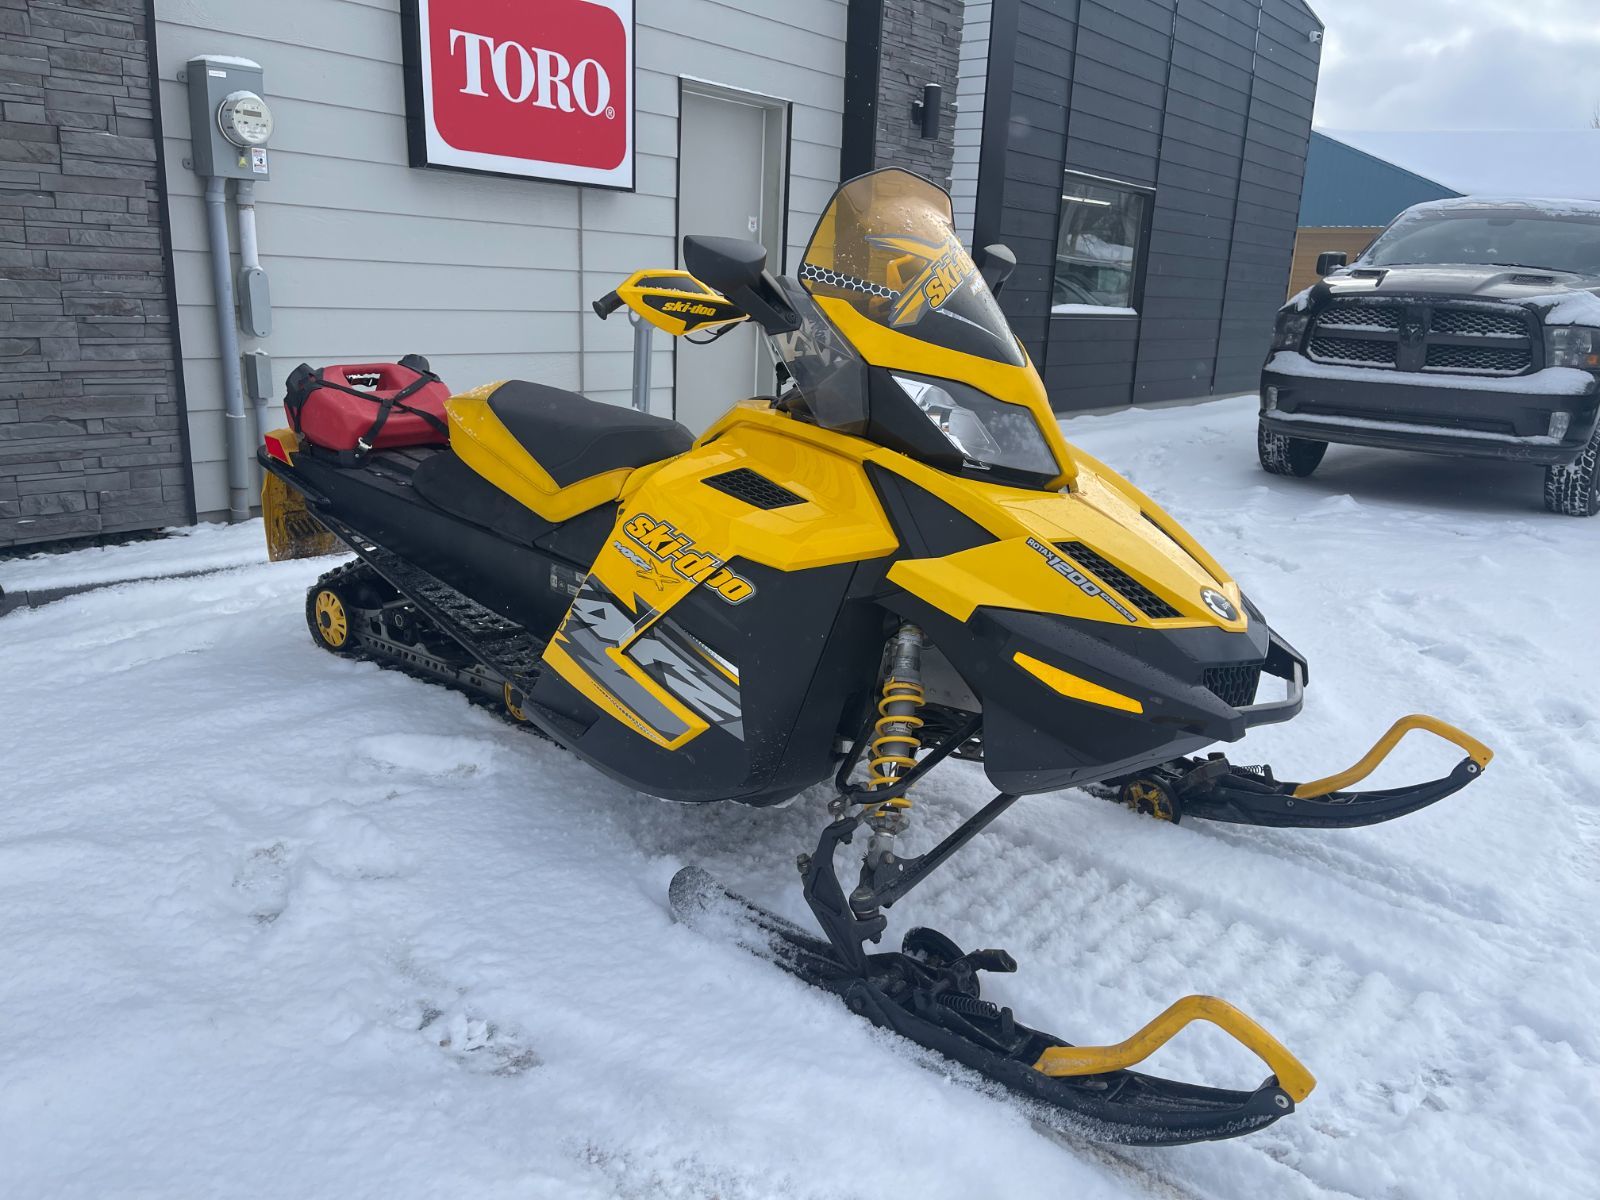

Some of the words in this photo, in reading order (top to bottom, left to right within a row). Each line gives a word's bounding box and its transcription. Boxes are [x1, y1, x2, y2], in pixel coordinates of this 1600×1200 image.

[661, 301, 717, 317] ski-doo
[624, 514, 755, 604] ski-doo
[1027, 538, 1054, 560] ROTAX
[1048, 555, 1101, 596] 1200
